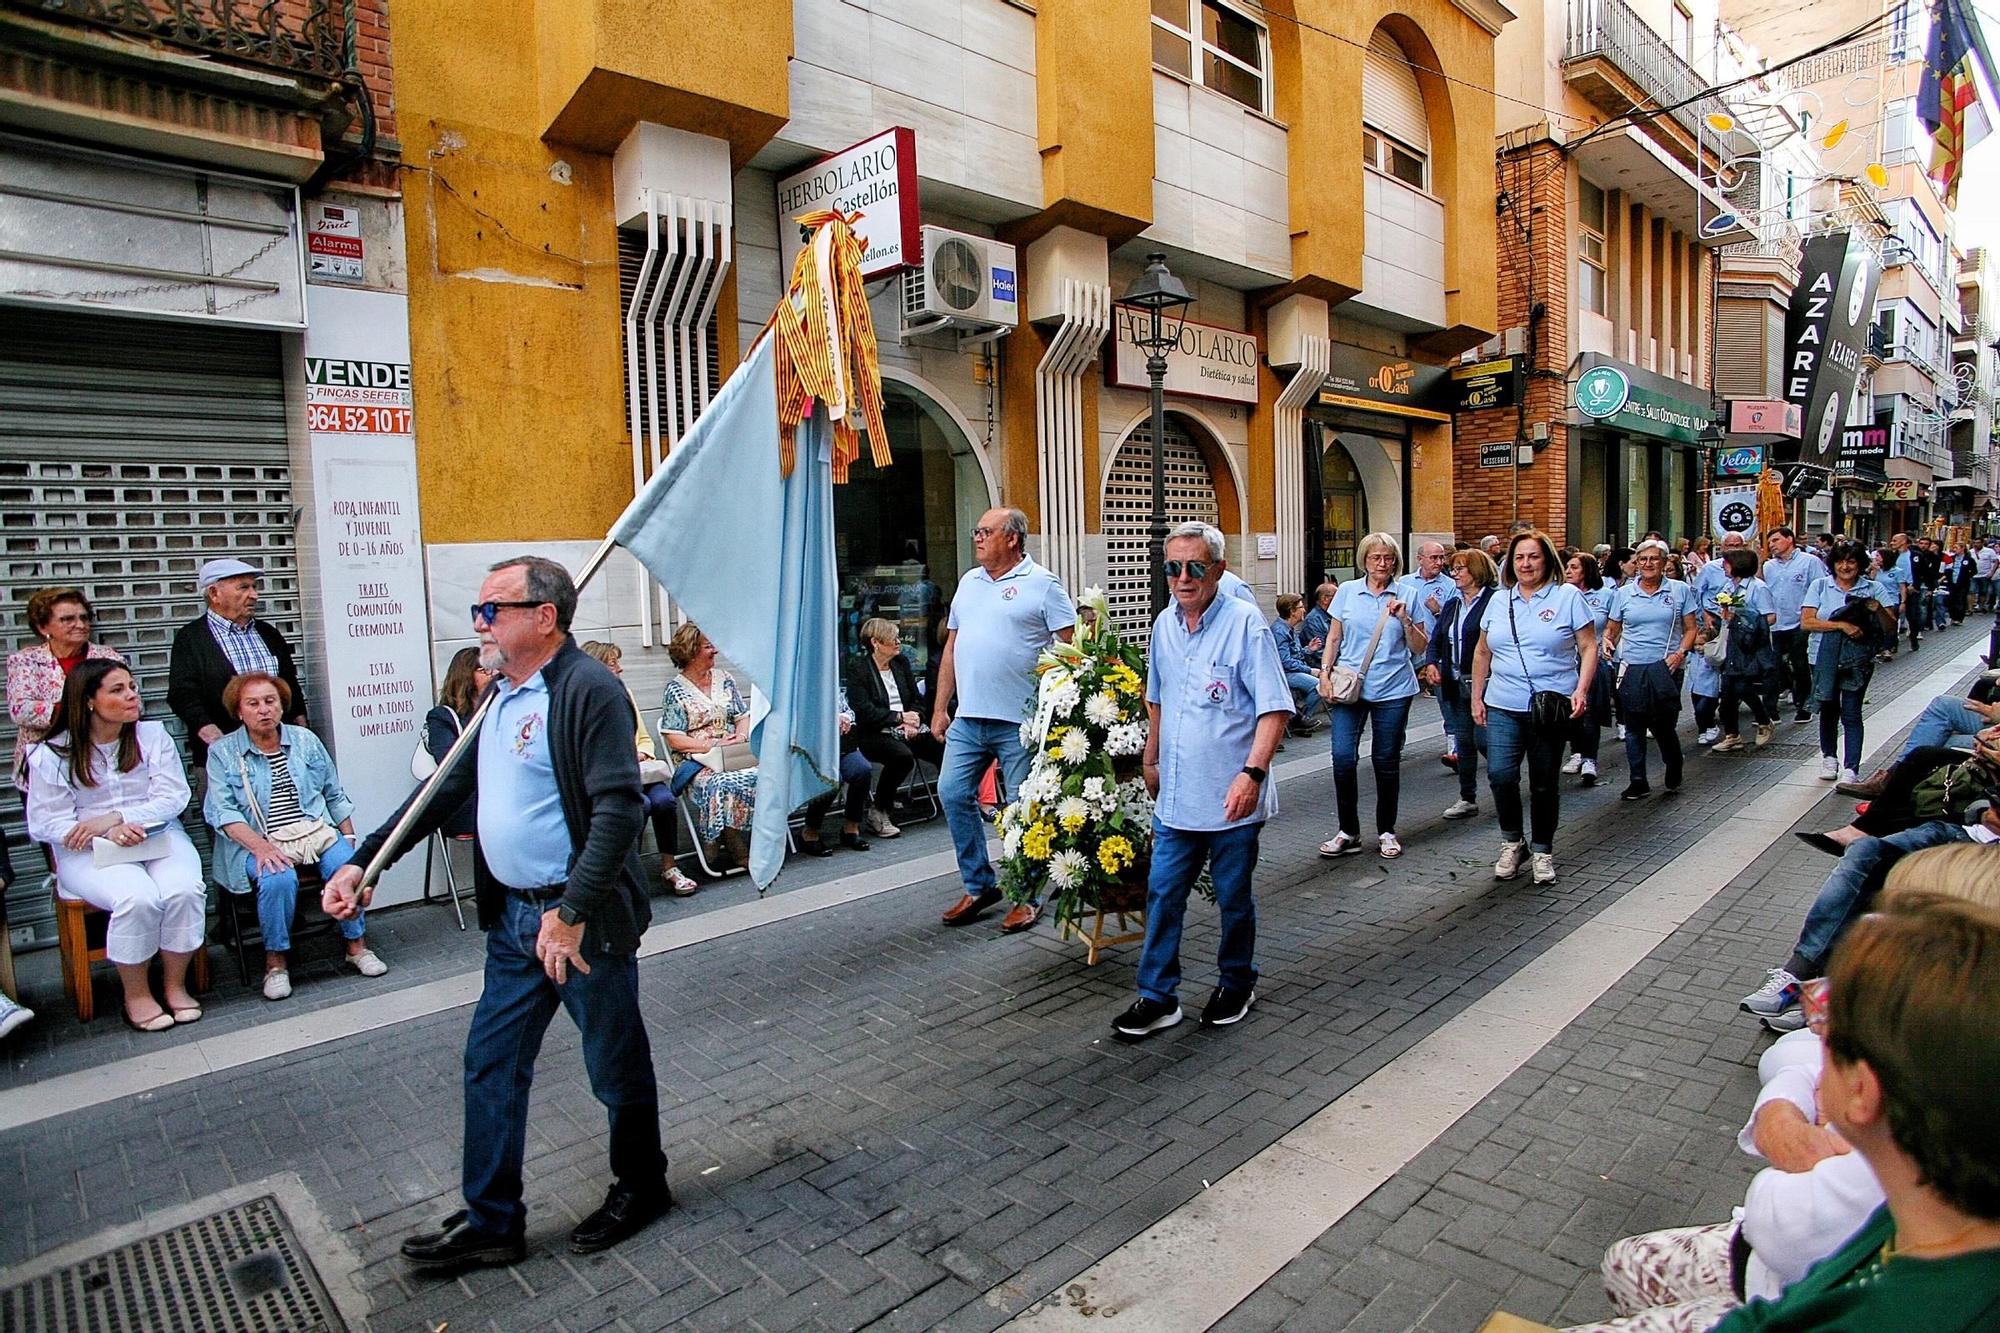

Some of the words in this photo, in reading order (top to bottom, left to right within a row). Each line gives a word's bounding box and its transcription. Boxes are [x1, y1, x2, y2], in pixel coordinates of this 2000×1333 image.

[780, 145, 896, 215] HERBOLARIO
[832, 179, 898, 215] Castellón
[315, 220, 353, 230] Direct
[312, 236, 360, 251] Alarma
[993, 278, 1015, 292] Haier
[1118, 312, 1257, 368] HEBOLARIO
[1789, 272, 1832, 407] AZARE
[1828, 339, 1858, 371] AZARES
[304, 358, 410, 389] VENDE
[1200, 366, 1231, 382] Dietética
[1231, 374, 1237, 386] y
[1237, 372, 1256, 386] salud
[316, 387, 360, 399] FINCAS
[362, 390, 399, 400] SEFER
[307, 405, 341, 431] 964
[344, 407, 369, 432] 52
[371, 408, 393, 433] 10
[395, 409, 411, 433] 17
[1842, 428, 1887, 447] mm
[1859, 446, 1884, 455] moda
[1719, 453, 1761, 467] Velvet
[333, 500, 356, 516] ROPA
[358, 500, 401, 516] INFANTIL
[346, 521, 351, 536] Y
[353, 521, 392, 536] JUVENIL
[338, 542, 351, 557] DE
[379, 541, 404, 556] AÑOS
[358, 582, 389, 597] TRAJES
[346, 599, 403, 618] COMUNIÓN
[348, 622, 404, 638] CEREMONIA
[347, 679, 414, 698] NACIMIENTOS
